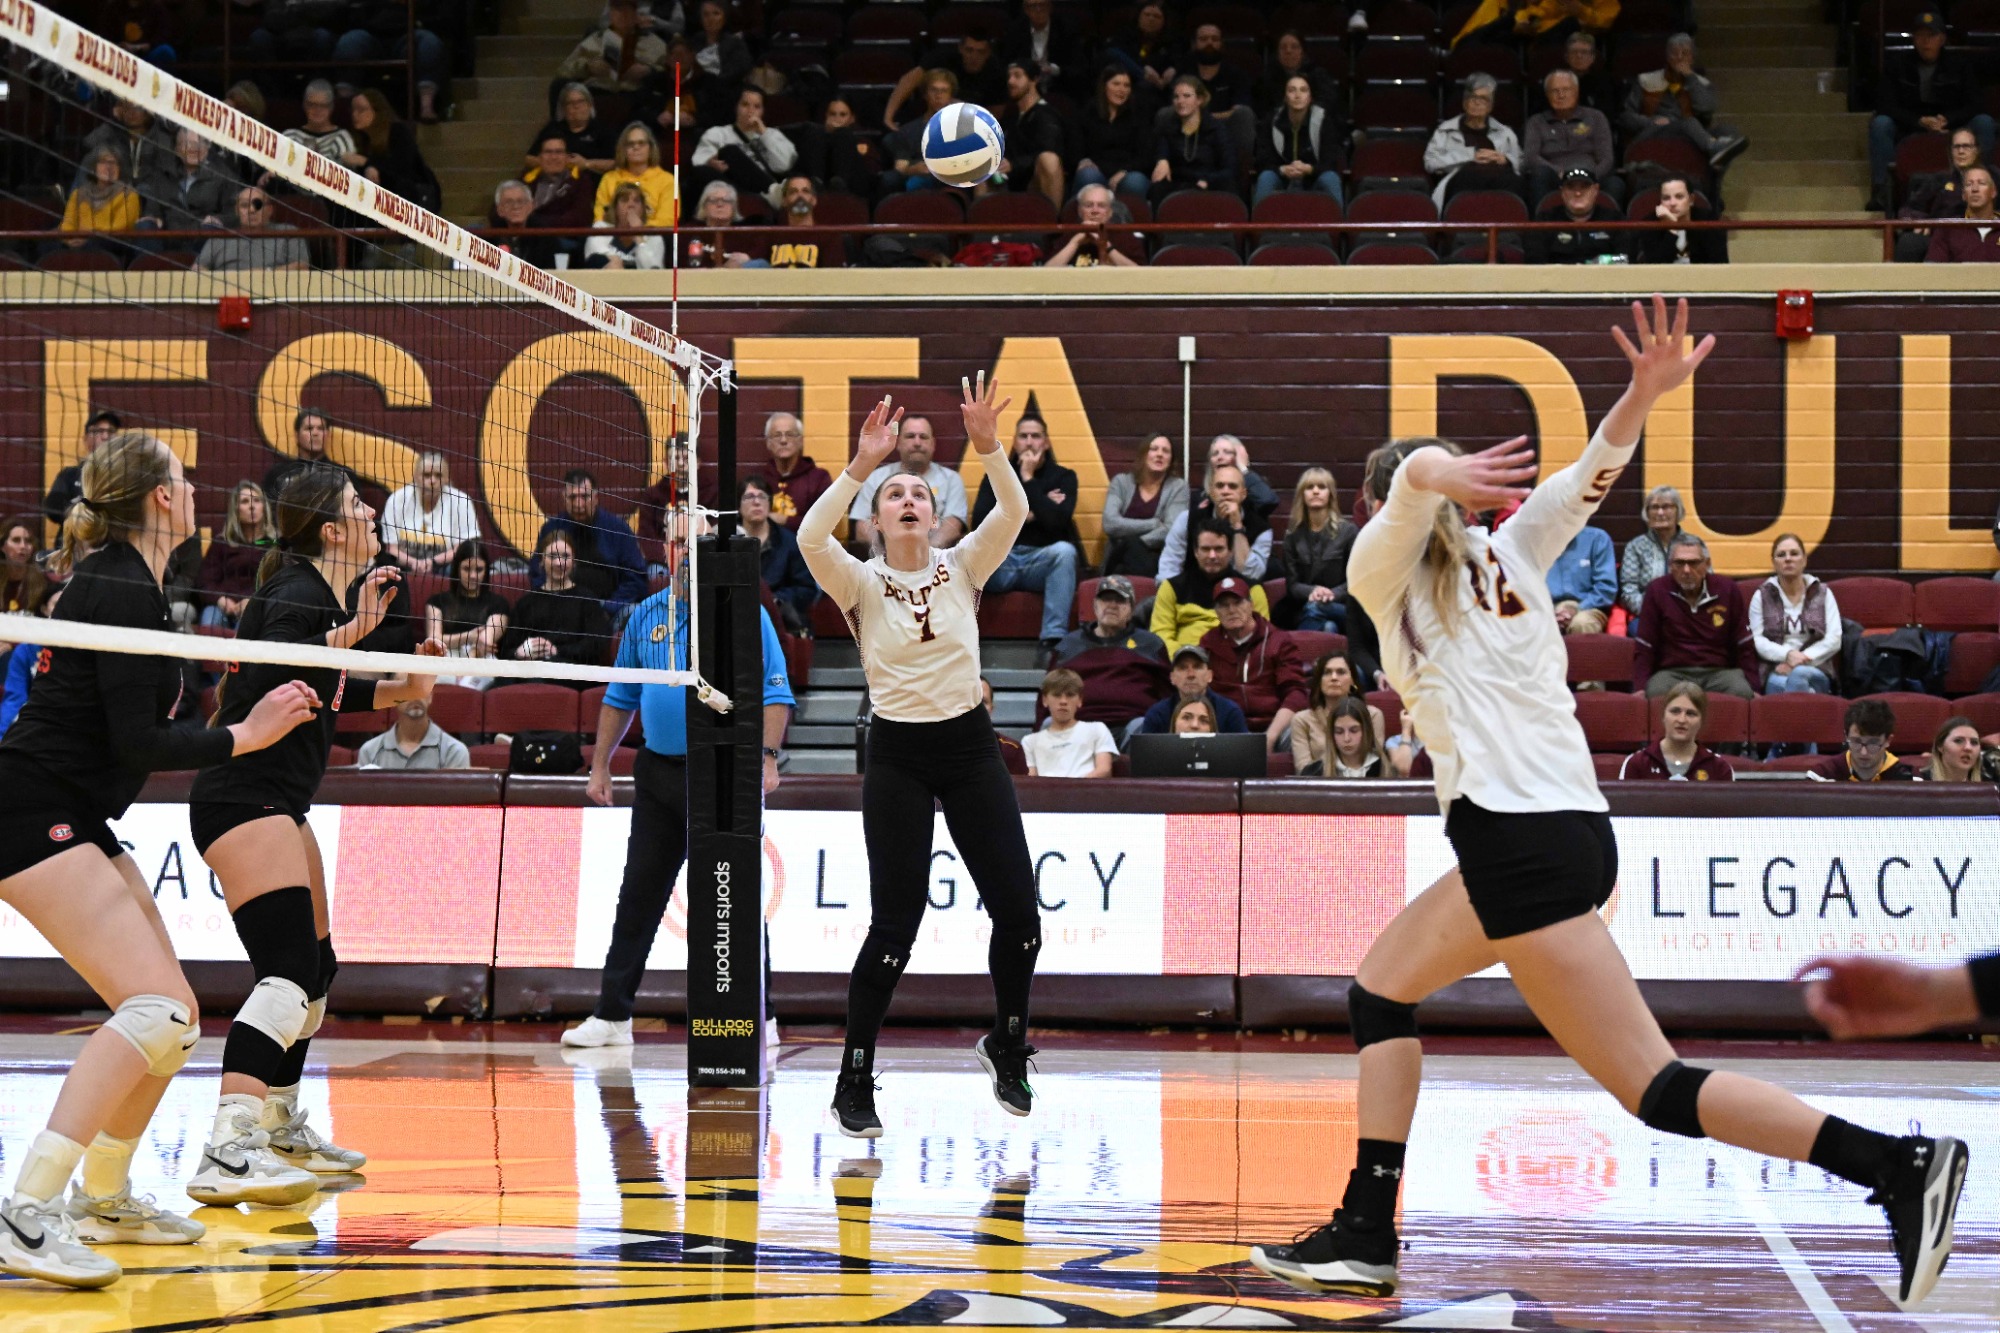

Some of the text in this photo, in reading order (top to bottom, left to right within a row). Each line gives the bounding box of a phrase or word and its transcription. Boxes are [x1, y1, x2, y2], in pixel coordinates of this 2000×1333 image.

[76, 30, 138, 88] BULLDOGS
[173, 82, 278, 160] MINNESOTA DULUTH
[304, 151, 350, 195] BULLDOGS
[374, 186, 419, 231] MINNESOTA
[815, 848, 1126, 911] LGCY
[1651, 856, 1972, 919] LEGACY
[713, 861, 732, 993] sports imports
[823, 924, 1107, 944] HOL GUP
[1661, 932, 1958, 952] HOTEL GROUP
[692, 1018, 754, 1029] BULLDOG
[692, 1027, 754, 1038] COUNTRY
